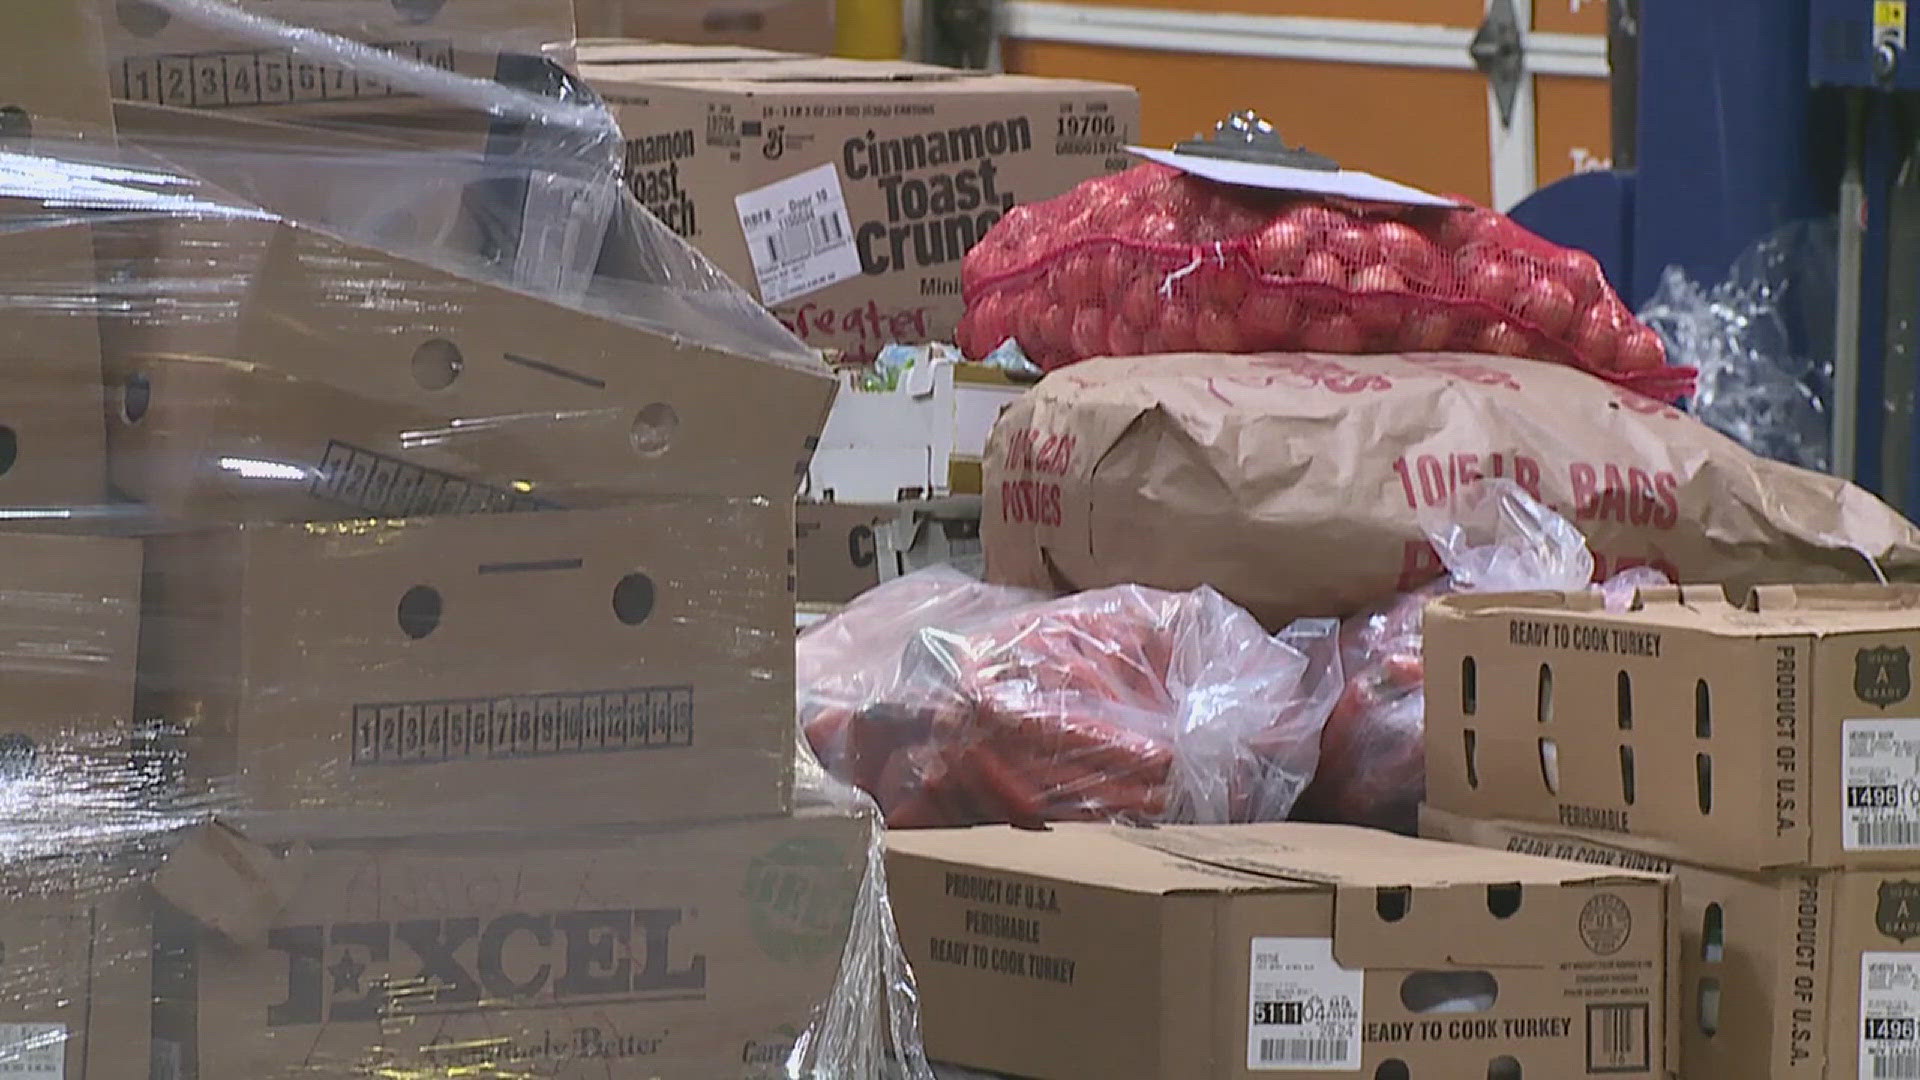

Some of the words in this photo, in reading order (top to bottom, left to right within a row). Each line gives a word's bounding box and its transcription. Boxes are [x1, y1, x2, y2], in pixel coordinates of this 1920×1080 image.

[168, 69, 185, 98] 2
[201, 67, 217, 95] 3
[234, 66, 250, 93] 4
[265, 64, 282, 93] 5
[843, 117, 1031, 180] Cinnamon
[878, 158, 997, 223] Toast
[779, 299, 928, 340] reater
[1570, 462, 1679, 530] BAGS
[1509, 619, 1550, 648] READY
[1553, 624, 1570, 650] TO
[1573, 625, 1609, 653] COOK
[1612, 630, 1661, 658] TURKEY
[1776, 645, 1796, 740] PRODUCT
[1776, 747, 1796, 773] OF
[1849, 787, 1898, 807] 1496
[1558, 804, 1630, 834] PERISHABLE
[945, 872, 1001, 905] PRODUCT
[1005, 883, 1022, 907] OF
[965, 910, 1041, 944] PERISHABLE
[1795, 874, 1818, 971] PRODUCT
[268, 909, 706, 1026] EXCEL
[930, 937, 969, 967] READY
[973, 944, 988, 969] TO
[991, 947, 1026, 976] COOK
[1029, 953, 1076, 986] TURKEY
[1794, 975, 1814, 1003] OF
[1254, 1001, 1302, 1024] 5111
[1420, 1020, 1443, 1041] TO
[1449, 1019, 1498, 1041] COOK
[1503, 1017, 1572, 1039] TURKEY
[1866, 1018, 1914, 1040] 1496
